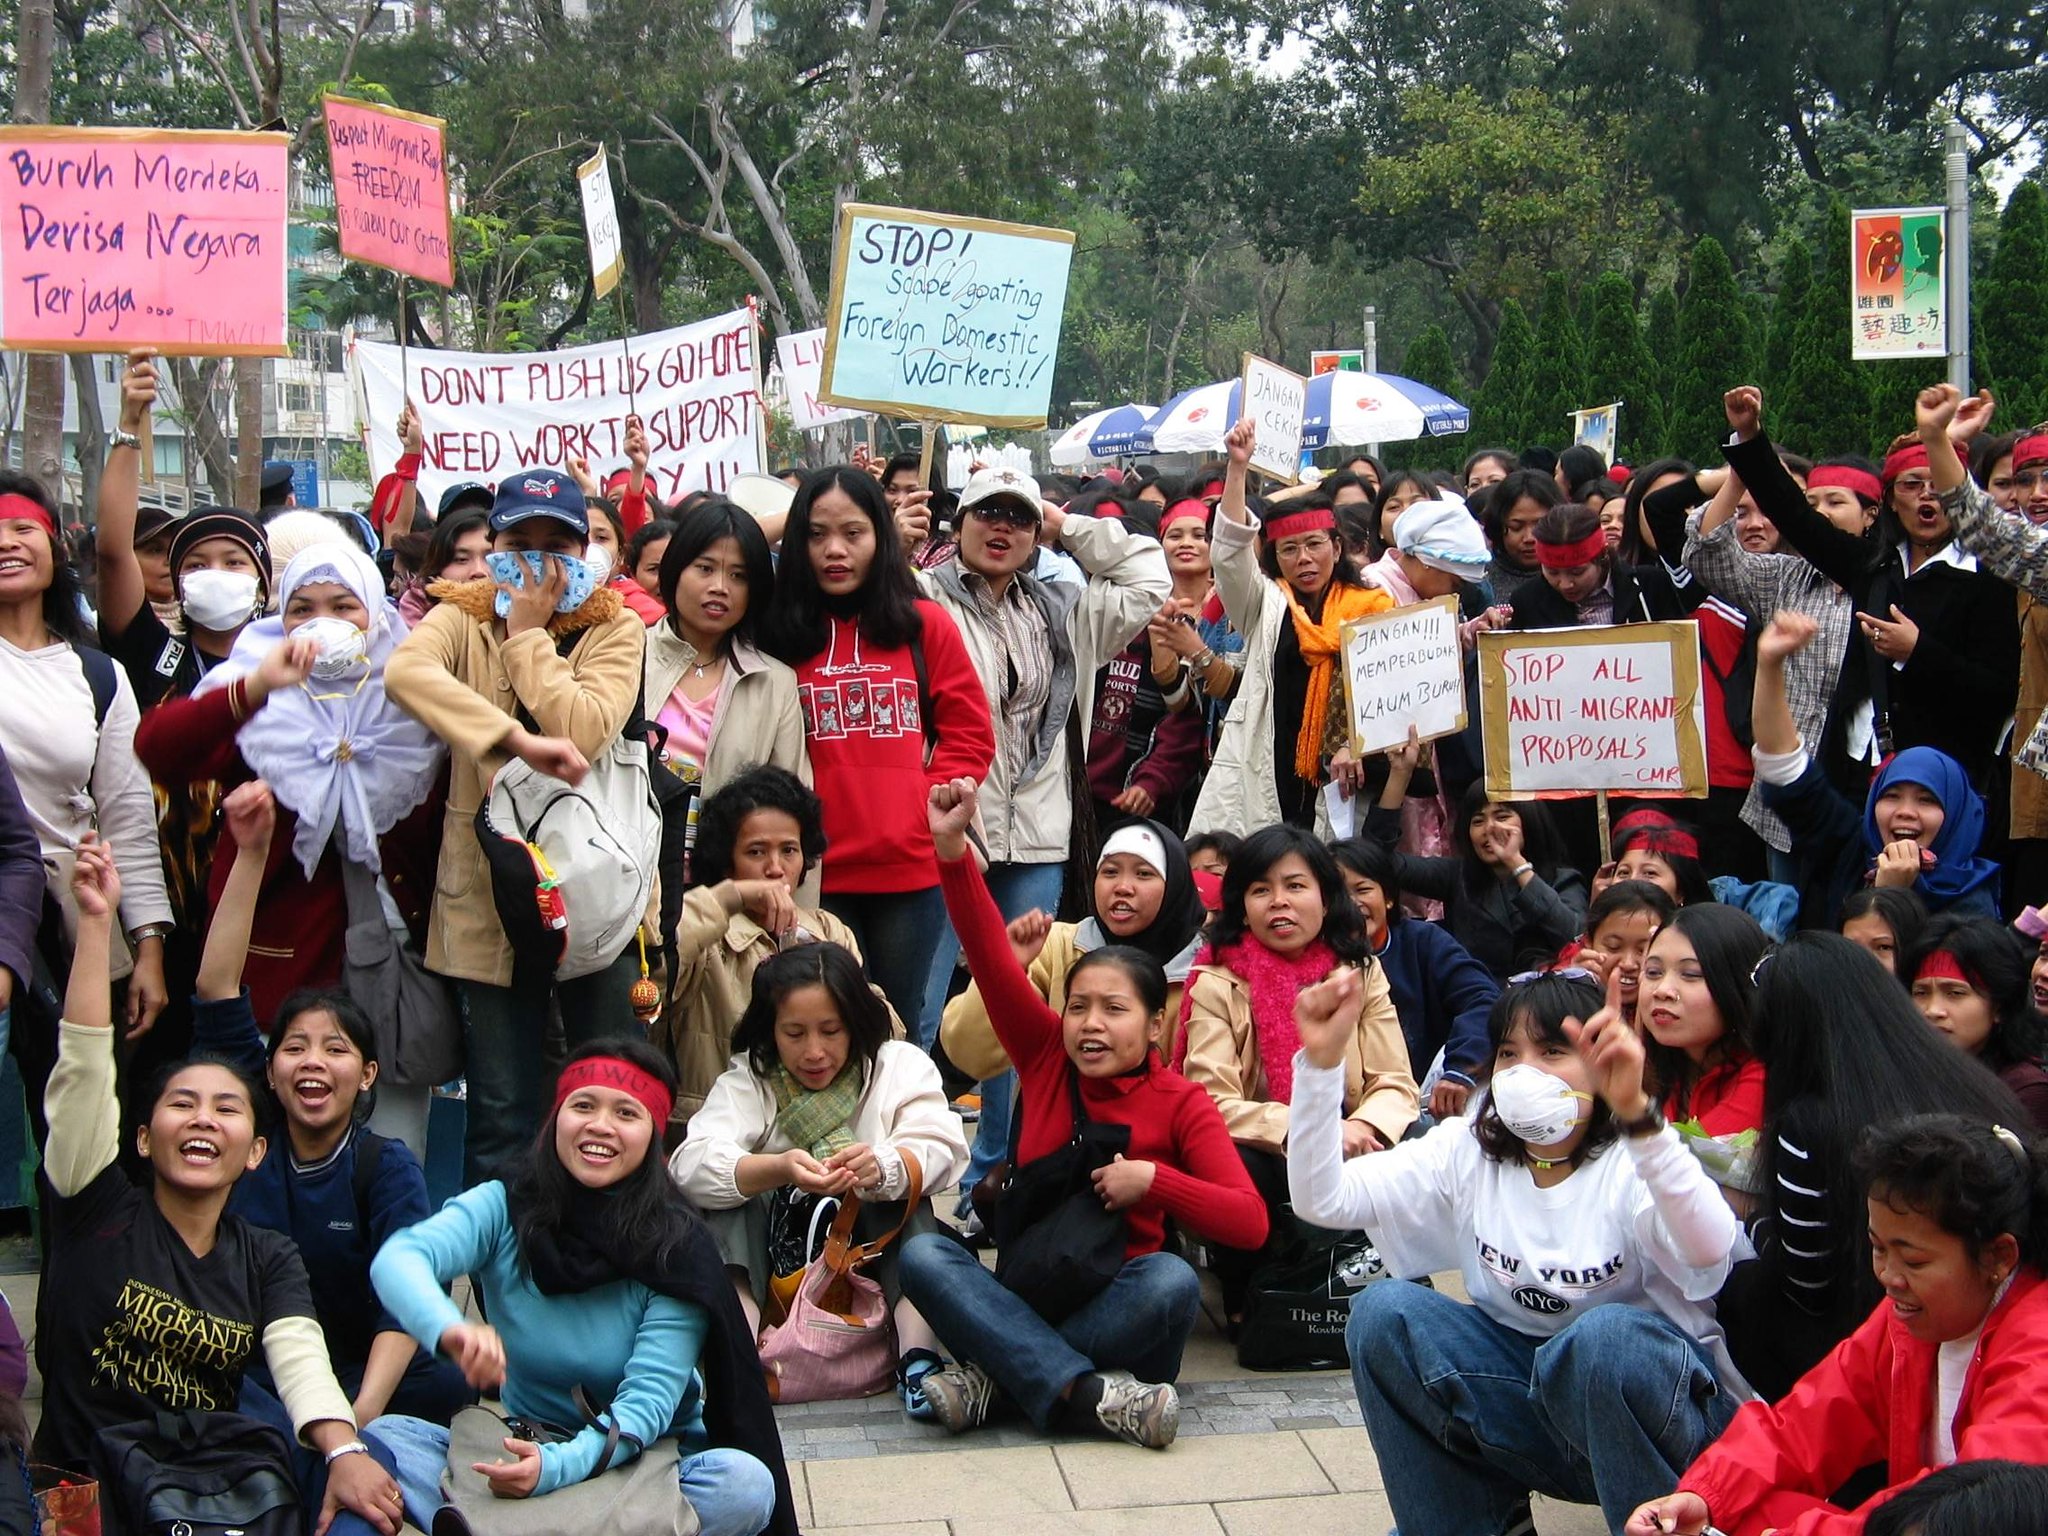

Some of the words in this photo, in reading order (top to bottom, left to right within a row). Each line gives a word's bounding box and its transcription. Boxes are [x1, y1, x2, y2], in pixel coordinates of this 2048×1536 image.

[352, 161, 421, 209] FREEDOM
[19, 203, 124, 253] Devisa
[147, 211, 260, 274] Negara
[859, 222, 973, 268] STOP!
[844, 301, 925, 356] Foreign
[942, 312, 1039, 356] Domestic
[421, 366, 513, 406] DON'T
[528, 356, 606, 401] PUSH
[617, 352, 650, 395] US
[1253, 372, 1301, 411] JANGAN
[421, 430, 500, 472] NEED
[509, 423, 601, 467] WORK
[1499, 649, 1565, 687] STOP
[1592, 657, 1644, 684] ALL
[1360, 692, 1412, 725] KAUM
[1539, 1250, 1625, 1285] YORK
[115, 1285, 255, 1357] MIGRANTS
[1288, 1307, 1322, 1322] The
[1519, 1289, 1560, 1313] NYC
